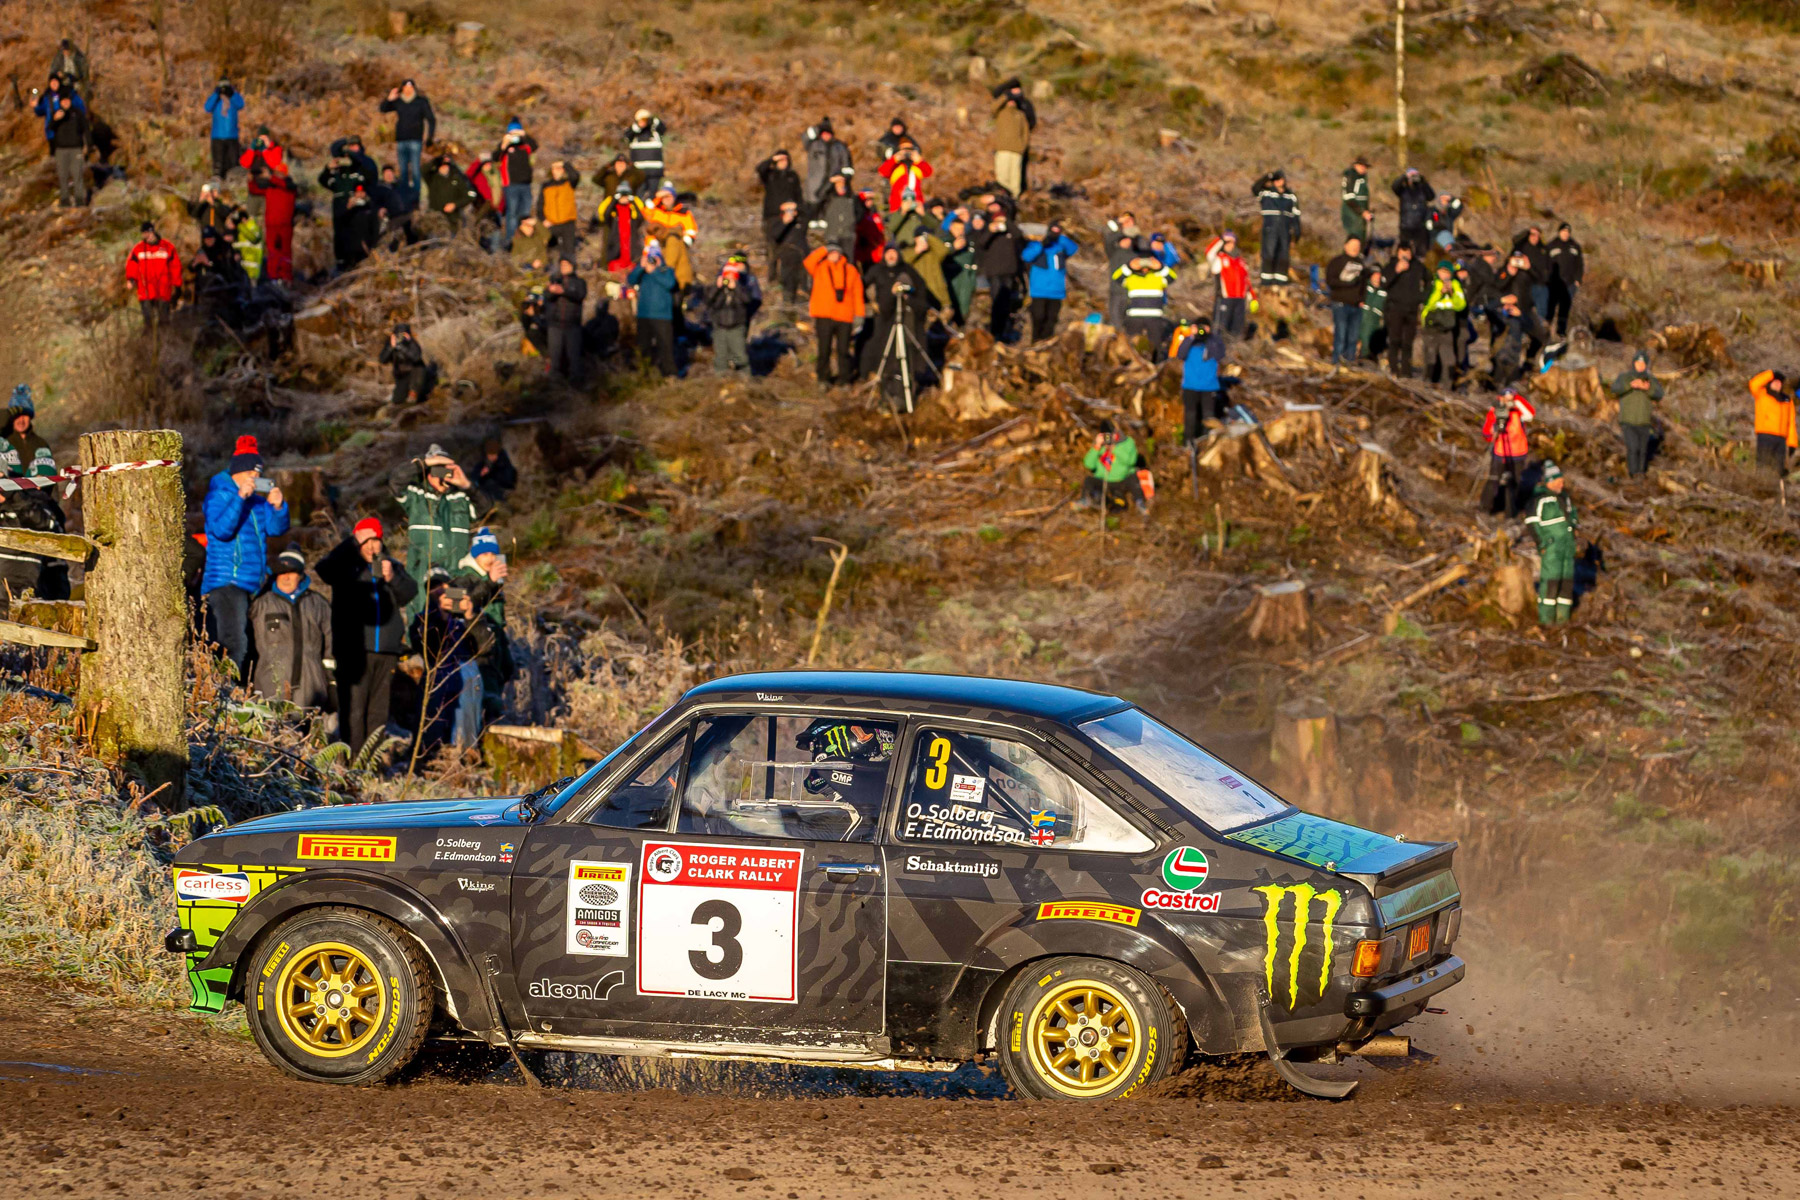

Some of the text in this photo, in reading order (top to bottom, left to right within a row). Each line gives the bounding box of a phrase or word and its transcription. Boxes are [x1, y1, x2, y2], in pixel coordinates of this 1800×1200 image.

[925, 737, 951, 790] 3
[831, 772, 853, 783] OMP
[907, 803, 995, 828] O.Solberg
[904, 821, 1025, 843] E.Edmondson
[301, 836, 392, 858] PIRELLI
[436, 838, 481, 851] O.Solberg
[434, 851, 496, 862] E.Edmondson
[689, 854, 795, 869] ROGER ALBERT
[578, 868, 622, 879] PIRELLI
[688, 867, 783, 882] CLARK RALLY
[906, 855, 999, 878] Schaktmiljö
[184, 878, 242, 890] carless
[1143, 890, 1219, 911] Castrol
[577, 909, 617, 920] AMIGOS
[1041, 902, 1136, 923] PIRELLI
[688, 899, 743, 980] 3
[529, 978, 593, 1000] alcon
[688, 989, 701, 997] DE
[703, 990, 728, 998] LACY
